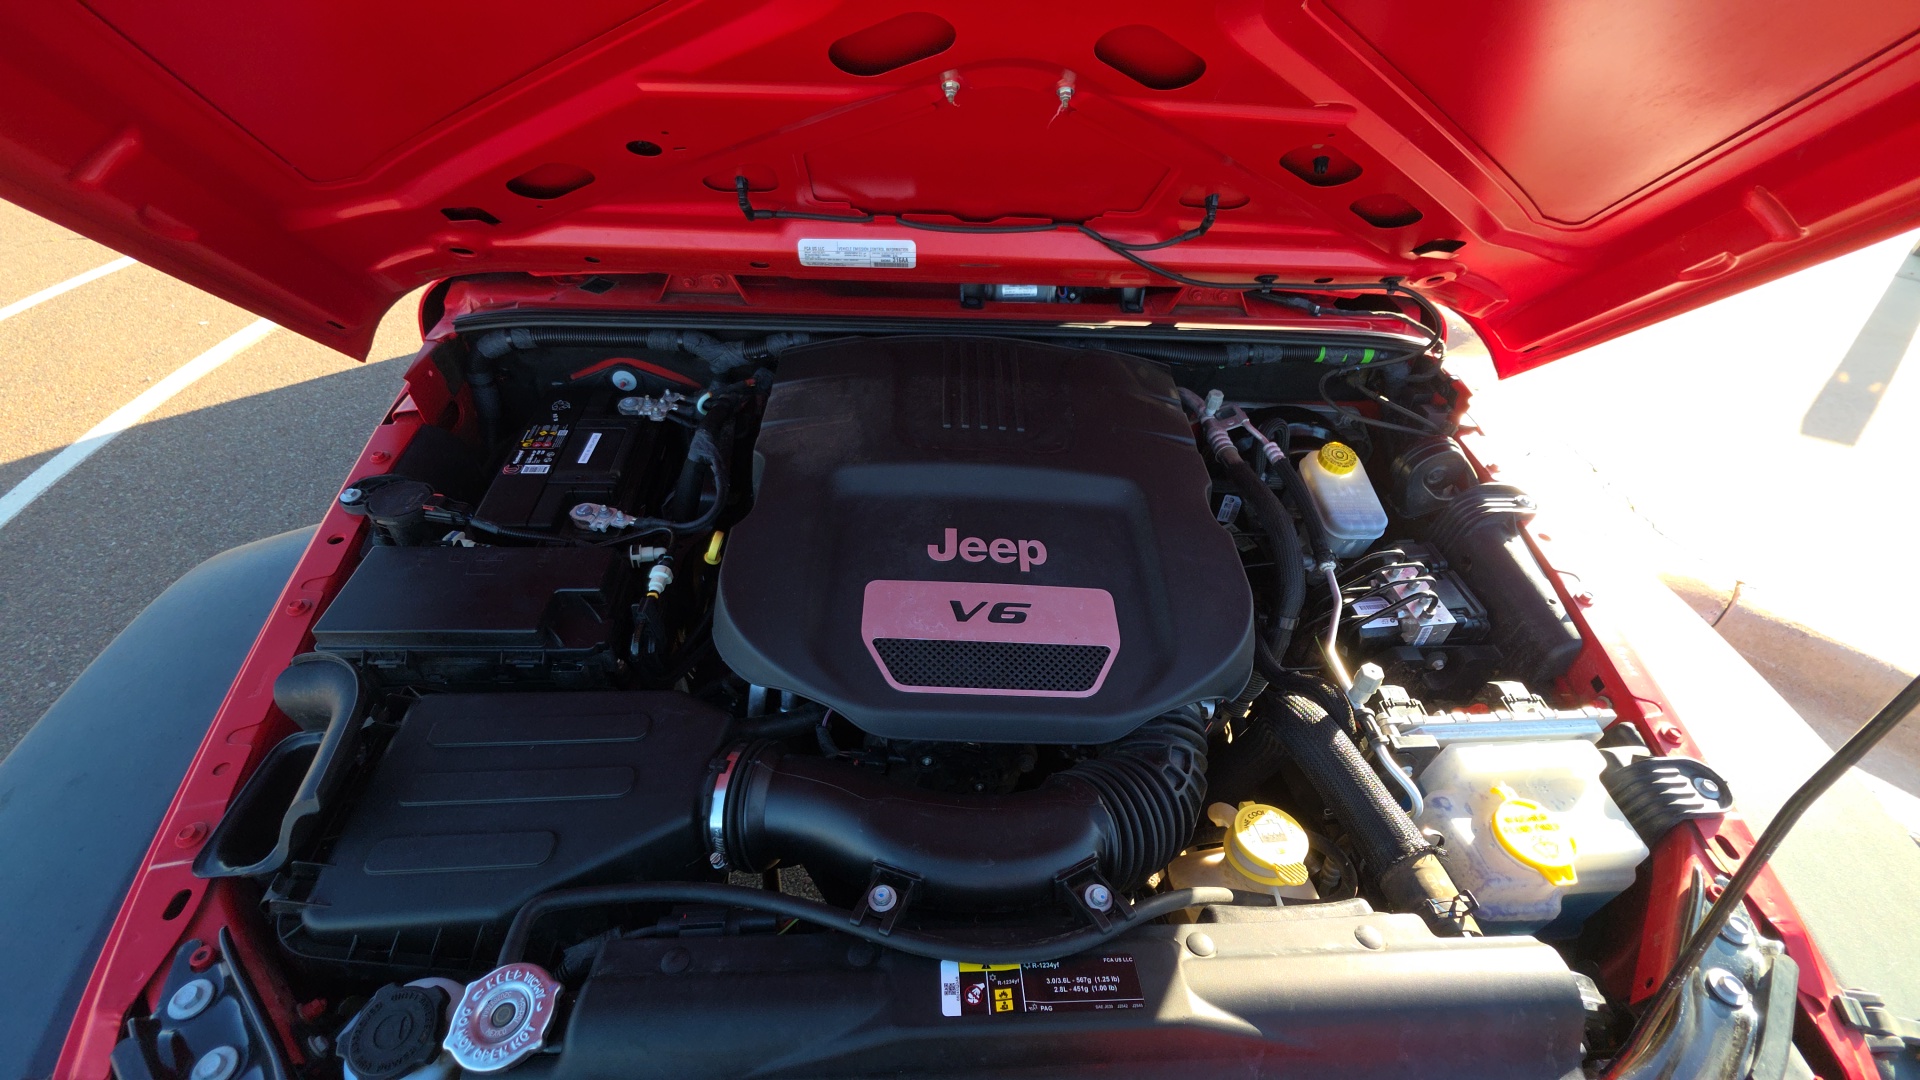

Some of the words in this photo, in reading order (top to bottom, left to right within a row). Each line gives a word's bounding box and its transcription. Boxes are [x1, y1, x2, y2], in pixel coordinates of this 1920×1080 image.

[927, 527, 1048, 572] Jeep
[949, 600, 1032, 624] V6
[1032, 962, 1060, 970] R-1234yf
